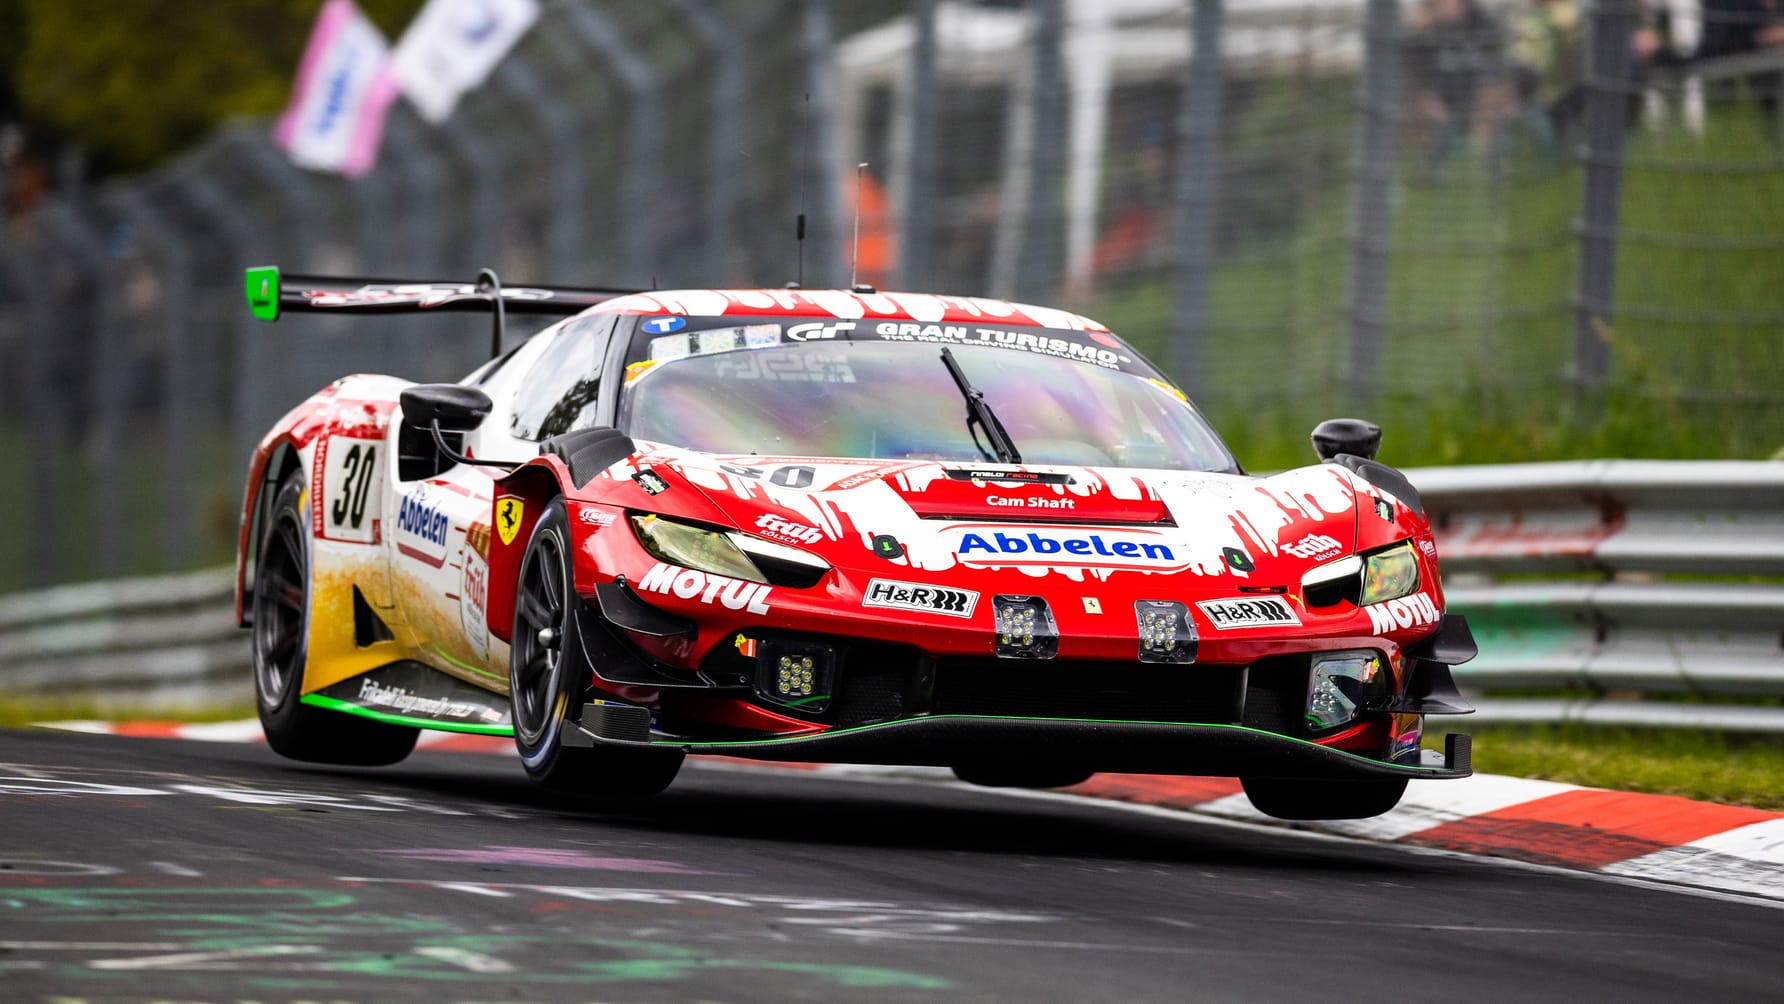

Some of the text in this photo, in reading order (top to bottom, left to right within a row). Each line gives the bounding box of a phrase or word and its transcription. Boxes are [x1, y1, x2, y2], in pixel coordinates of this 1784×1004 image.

[650, 317, 677, 332] T
[876, 322, 1119, 364] GRAN TURISMO
[917, 335, 963, 345] REAL
[965, 338, 1028, 351] DRIVING
[1030, 347, 1121, 370] SIMULATOR
[332, 444, 376, 529] 30
[986, 495, 1075, 509] Cam Shaft
[398, 495, 449, 547] Abbelen
[958, 532, 1176, 561] Abbelen
[638, 562, 773, 615] MOTUL
[872, 583, 932, 605] H&R
[1207, 602, 1262, 624] H&R
[1365, 592, 1440, 636] MOTUL
